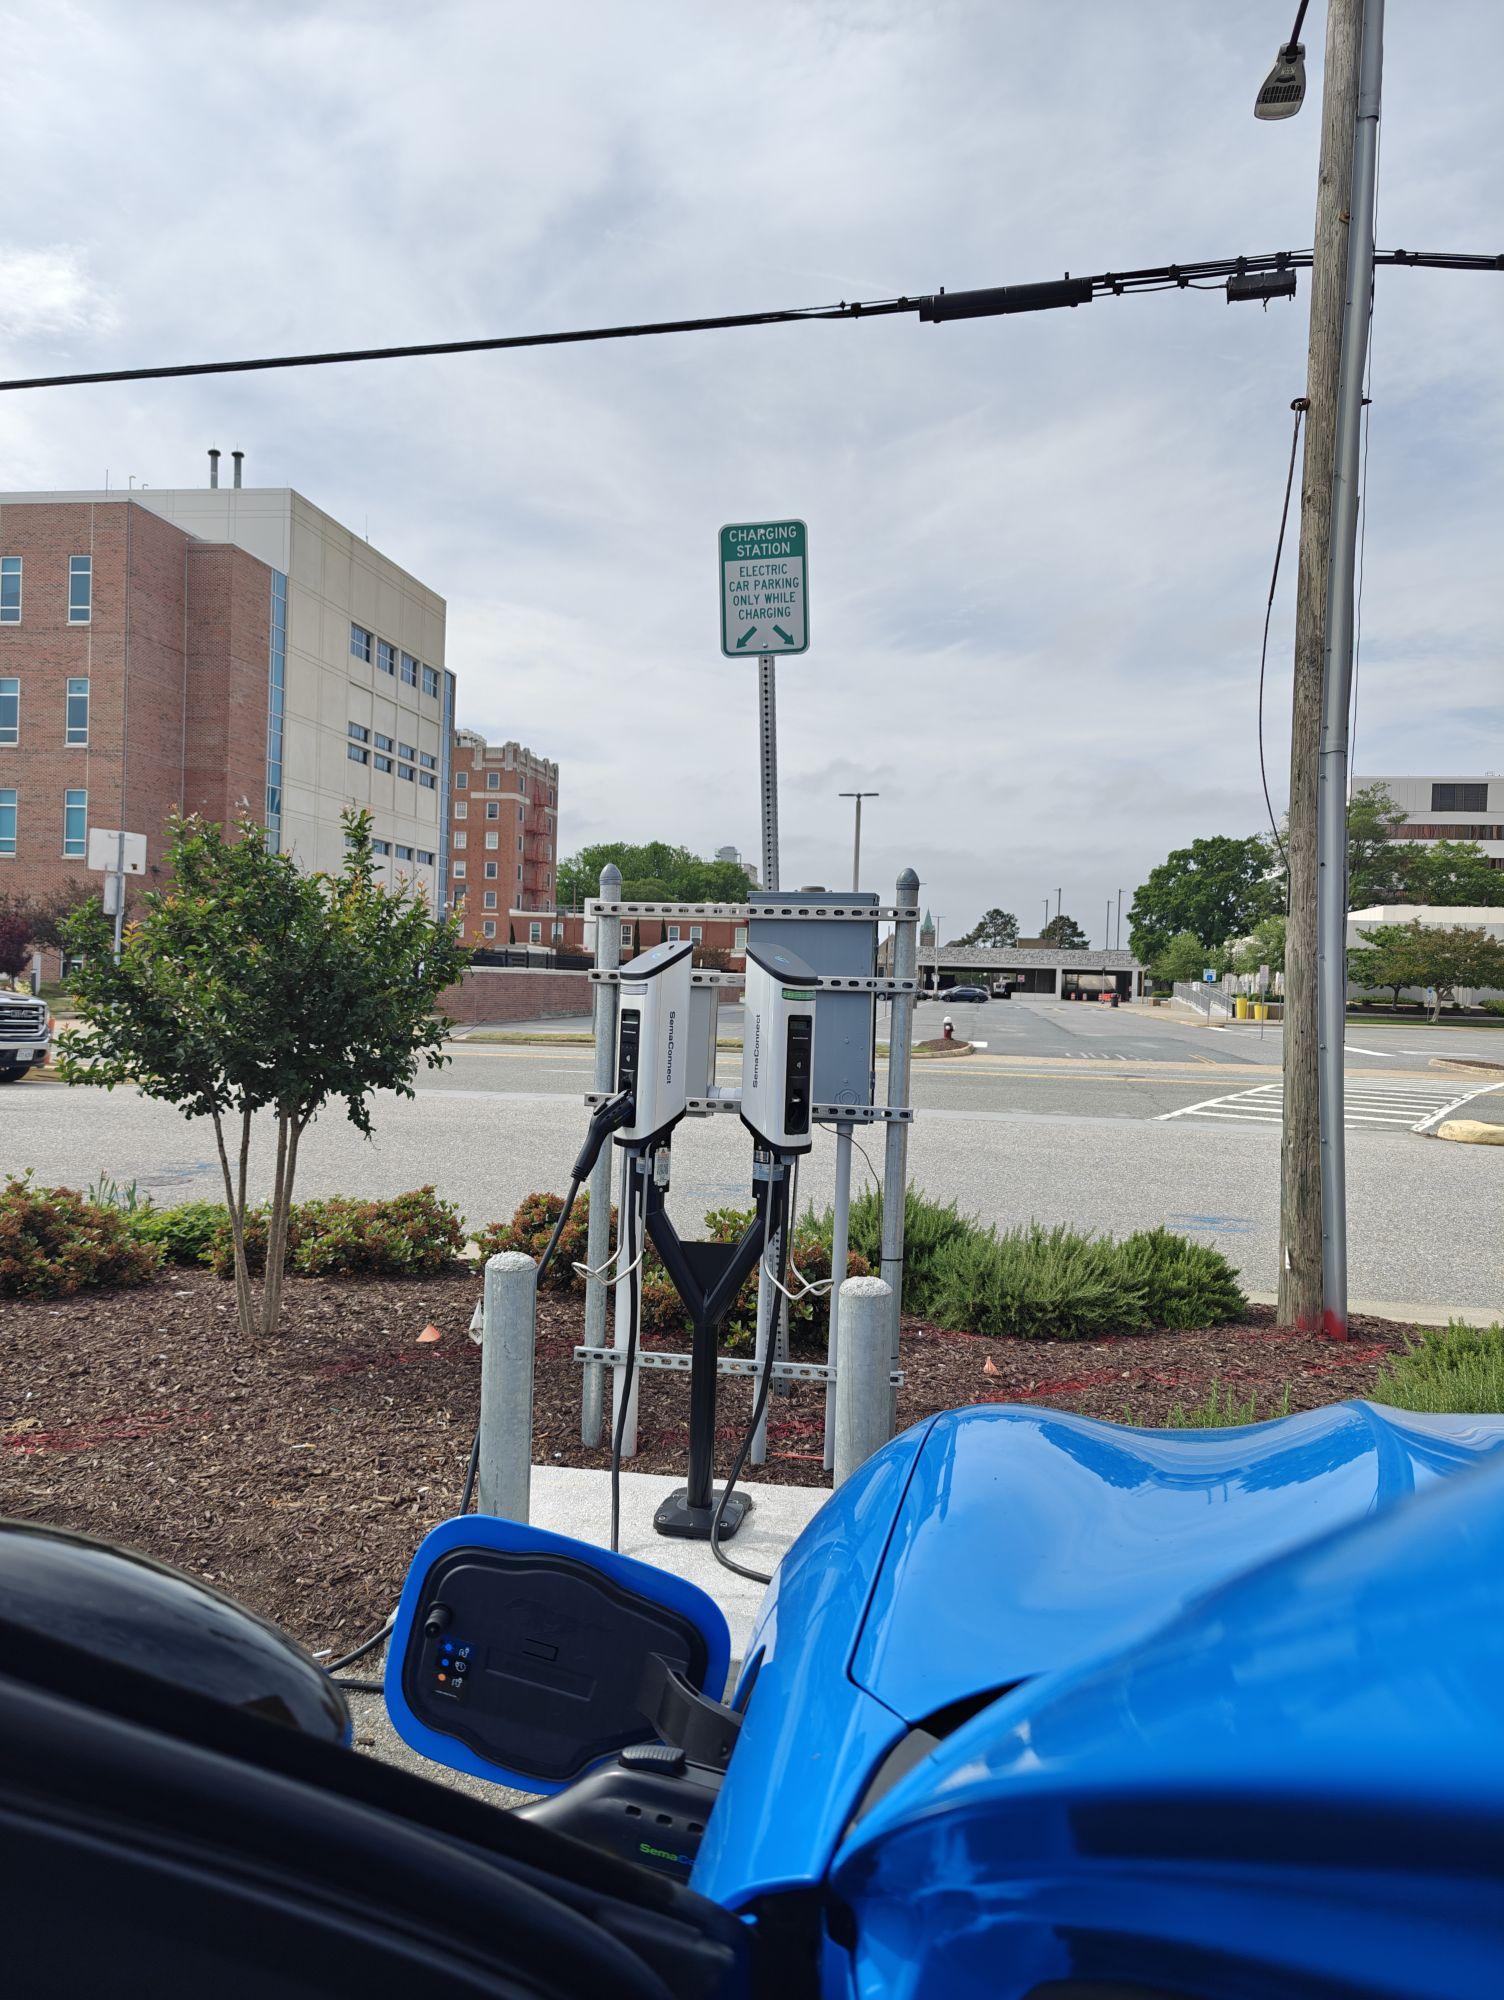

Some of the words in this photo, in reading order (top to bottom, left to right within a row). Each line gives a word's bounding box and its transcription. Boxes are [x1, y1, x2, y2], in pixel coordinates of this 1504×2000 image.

[729, 526, 797, 542] CHARGING
[736, 542, 791, 557] STATION
[739, 563, 788, 578] ELECTRIC
[729, 580, 749, 593] CAR
[754, 576, 800, 591] PARKING
[733, 594, 760, 607] ONLY
[764, 591, 796, 604] WHILE
[738, 606, 791, 620] CHARGING
[666, 1011, 676, 1084] SemaConnect
[752, 1014, 761, 1088] SemaConnect
